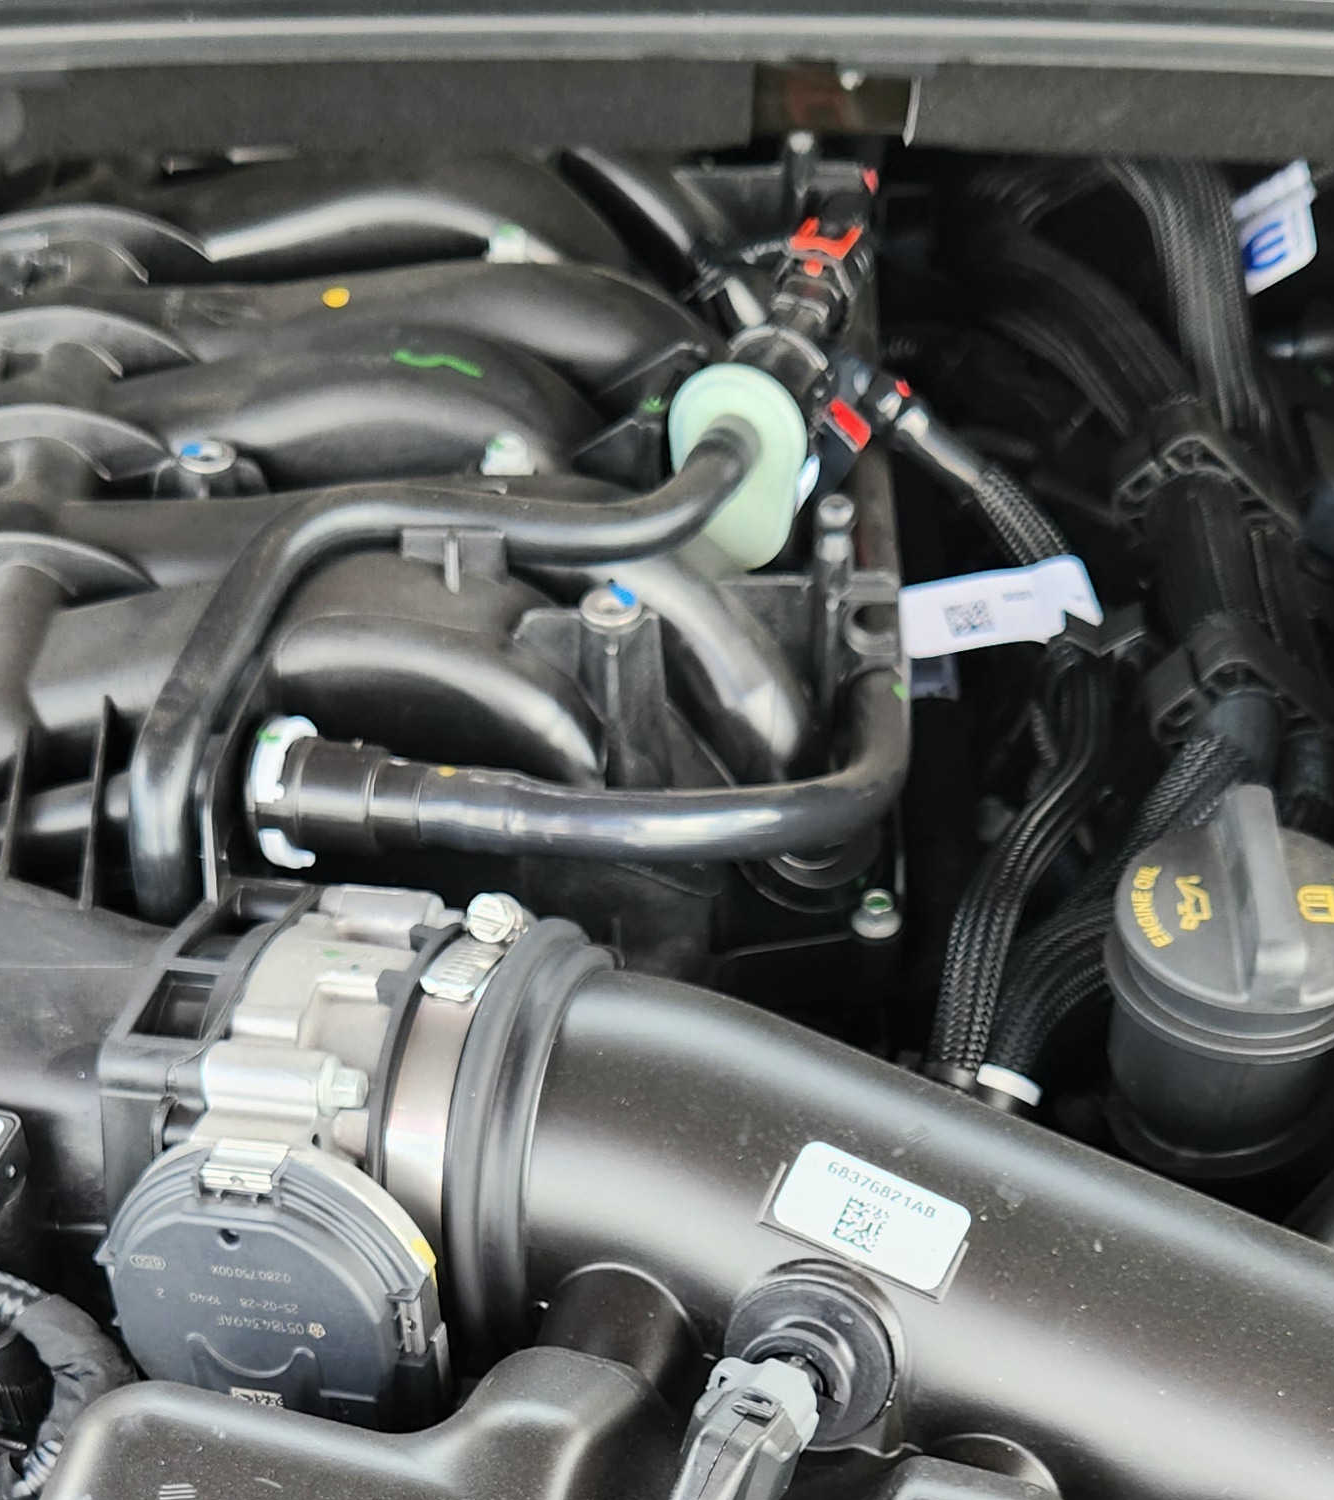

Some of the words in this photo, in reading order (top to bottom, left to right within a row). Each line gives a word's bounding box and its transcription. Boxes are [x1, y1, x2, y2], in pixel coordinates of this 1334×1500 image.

[1133, 865, 1163, 890] OIL
[1131, 889, 1174, 948] ENGINE
[828, 1161, 937, 1219] 68376821AB
[239, 1298, 299, 1315] 25-02-28
